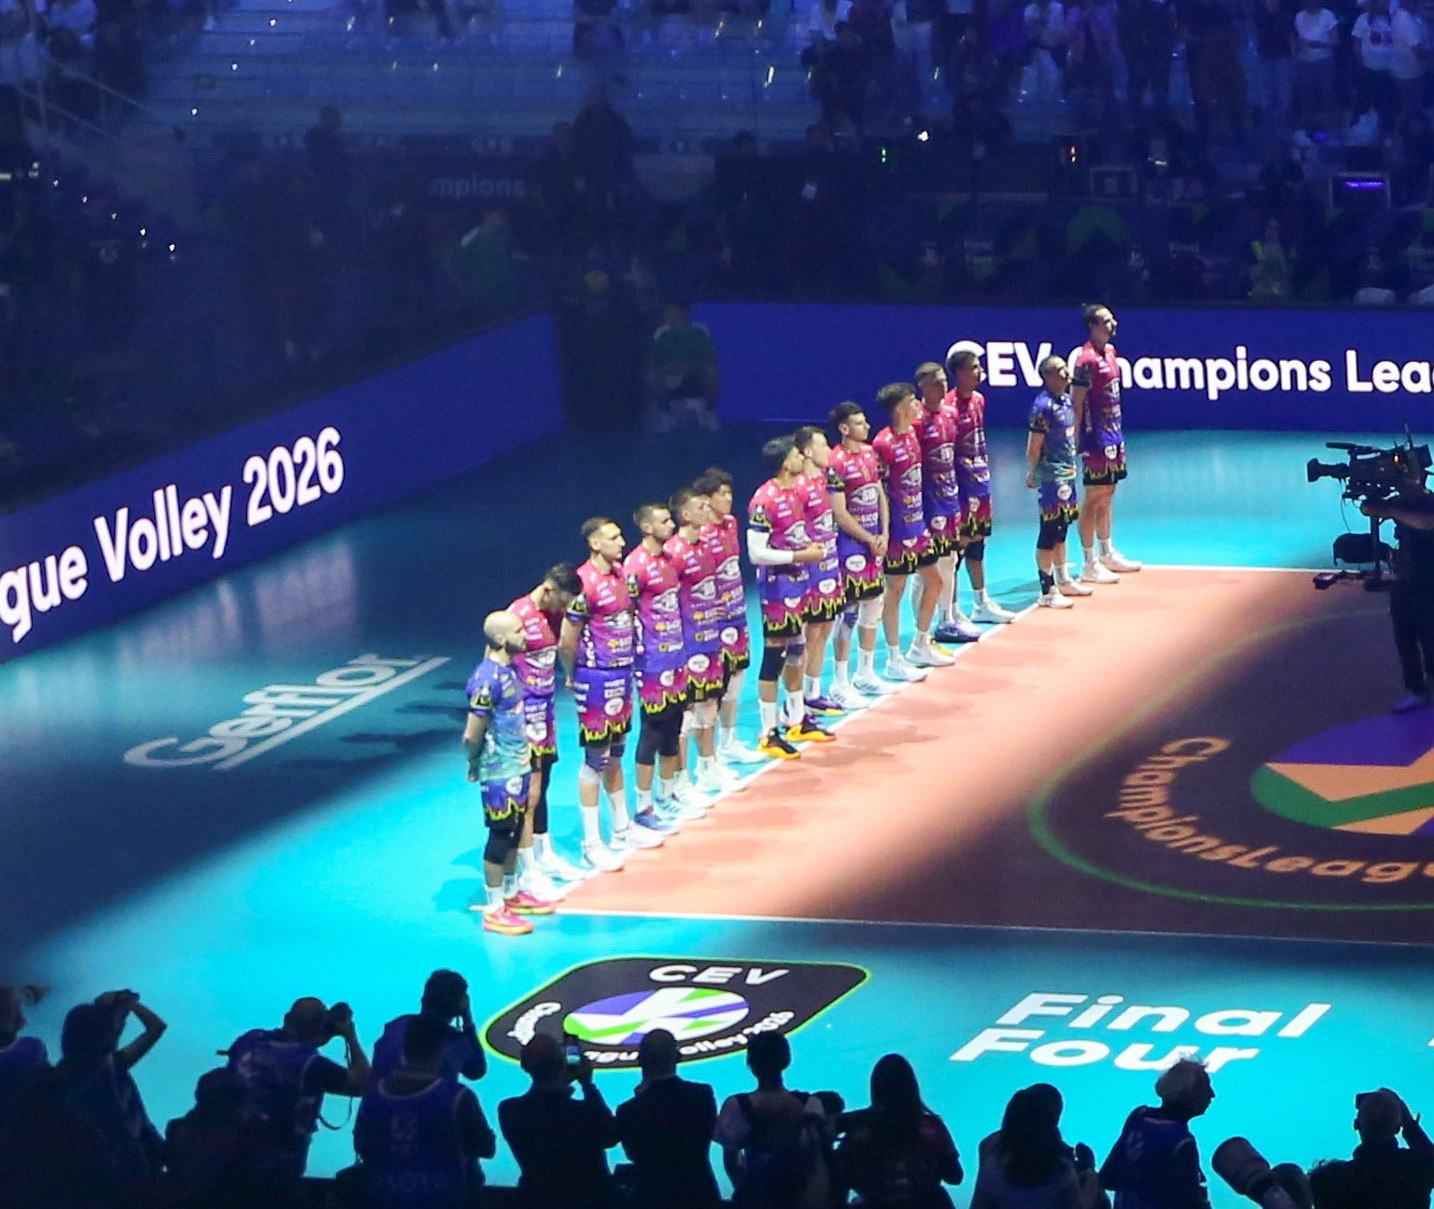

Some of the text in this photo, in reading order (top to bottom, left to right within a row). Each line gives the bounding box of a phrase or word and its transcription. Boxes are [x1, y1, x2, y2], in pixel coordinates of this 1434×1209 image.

[1067, 346, 1332, 401] ampions
[94, 484, 232, 583] Volley
[243, 426, 344, 527] 2026
[123, 653, 424, 768] Gerflor
[648, 964, 790, 985] CEV
[995, 992, 1332, 1038] Final
[949, 1028, 1260, 1073] Four
